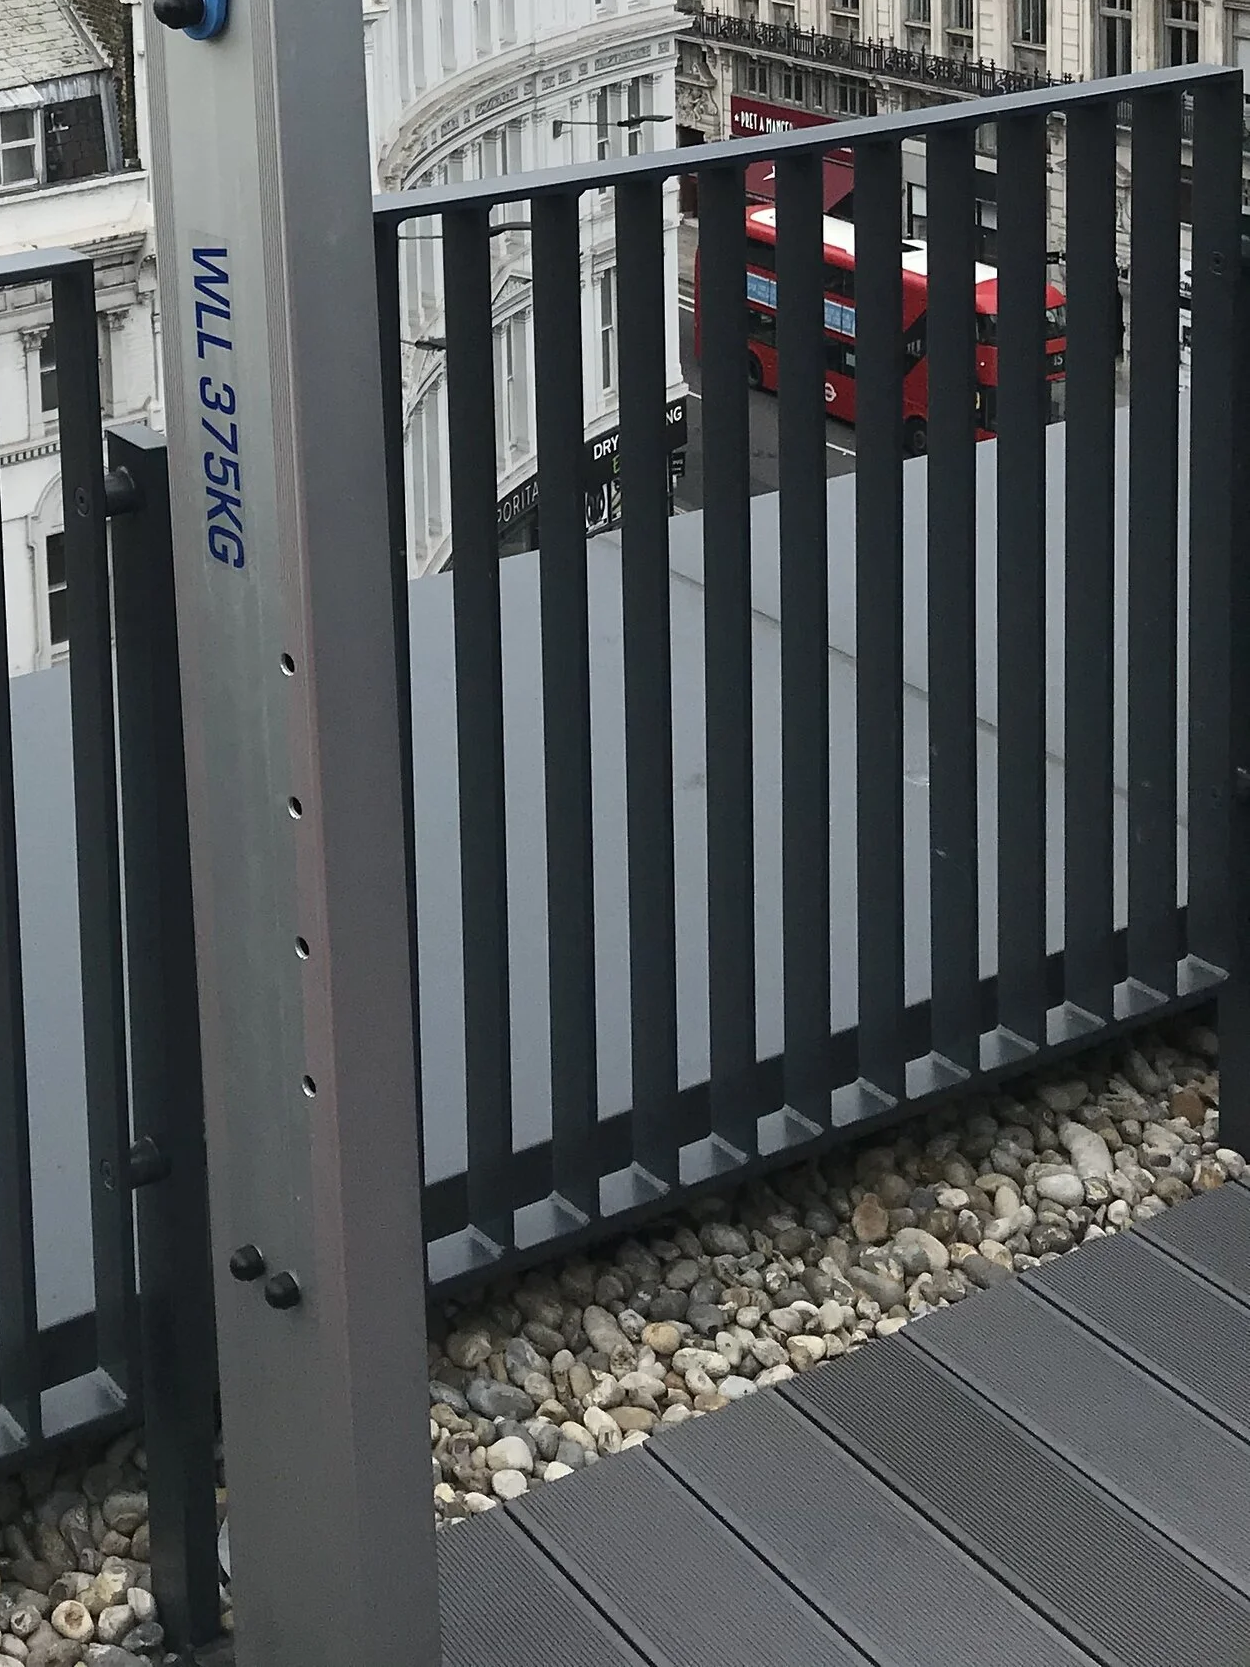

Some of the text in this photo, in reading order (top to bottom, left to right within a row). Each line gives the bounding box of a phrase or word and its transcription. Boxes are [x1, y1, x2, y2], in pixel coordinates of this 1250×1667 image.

[741, 111, 758, 130] PRET
[759, 116, 765, 133] A
[192, 248, 245, 569] WLL 375KG
[593, 434, 620, 460] DRY
